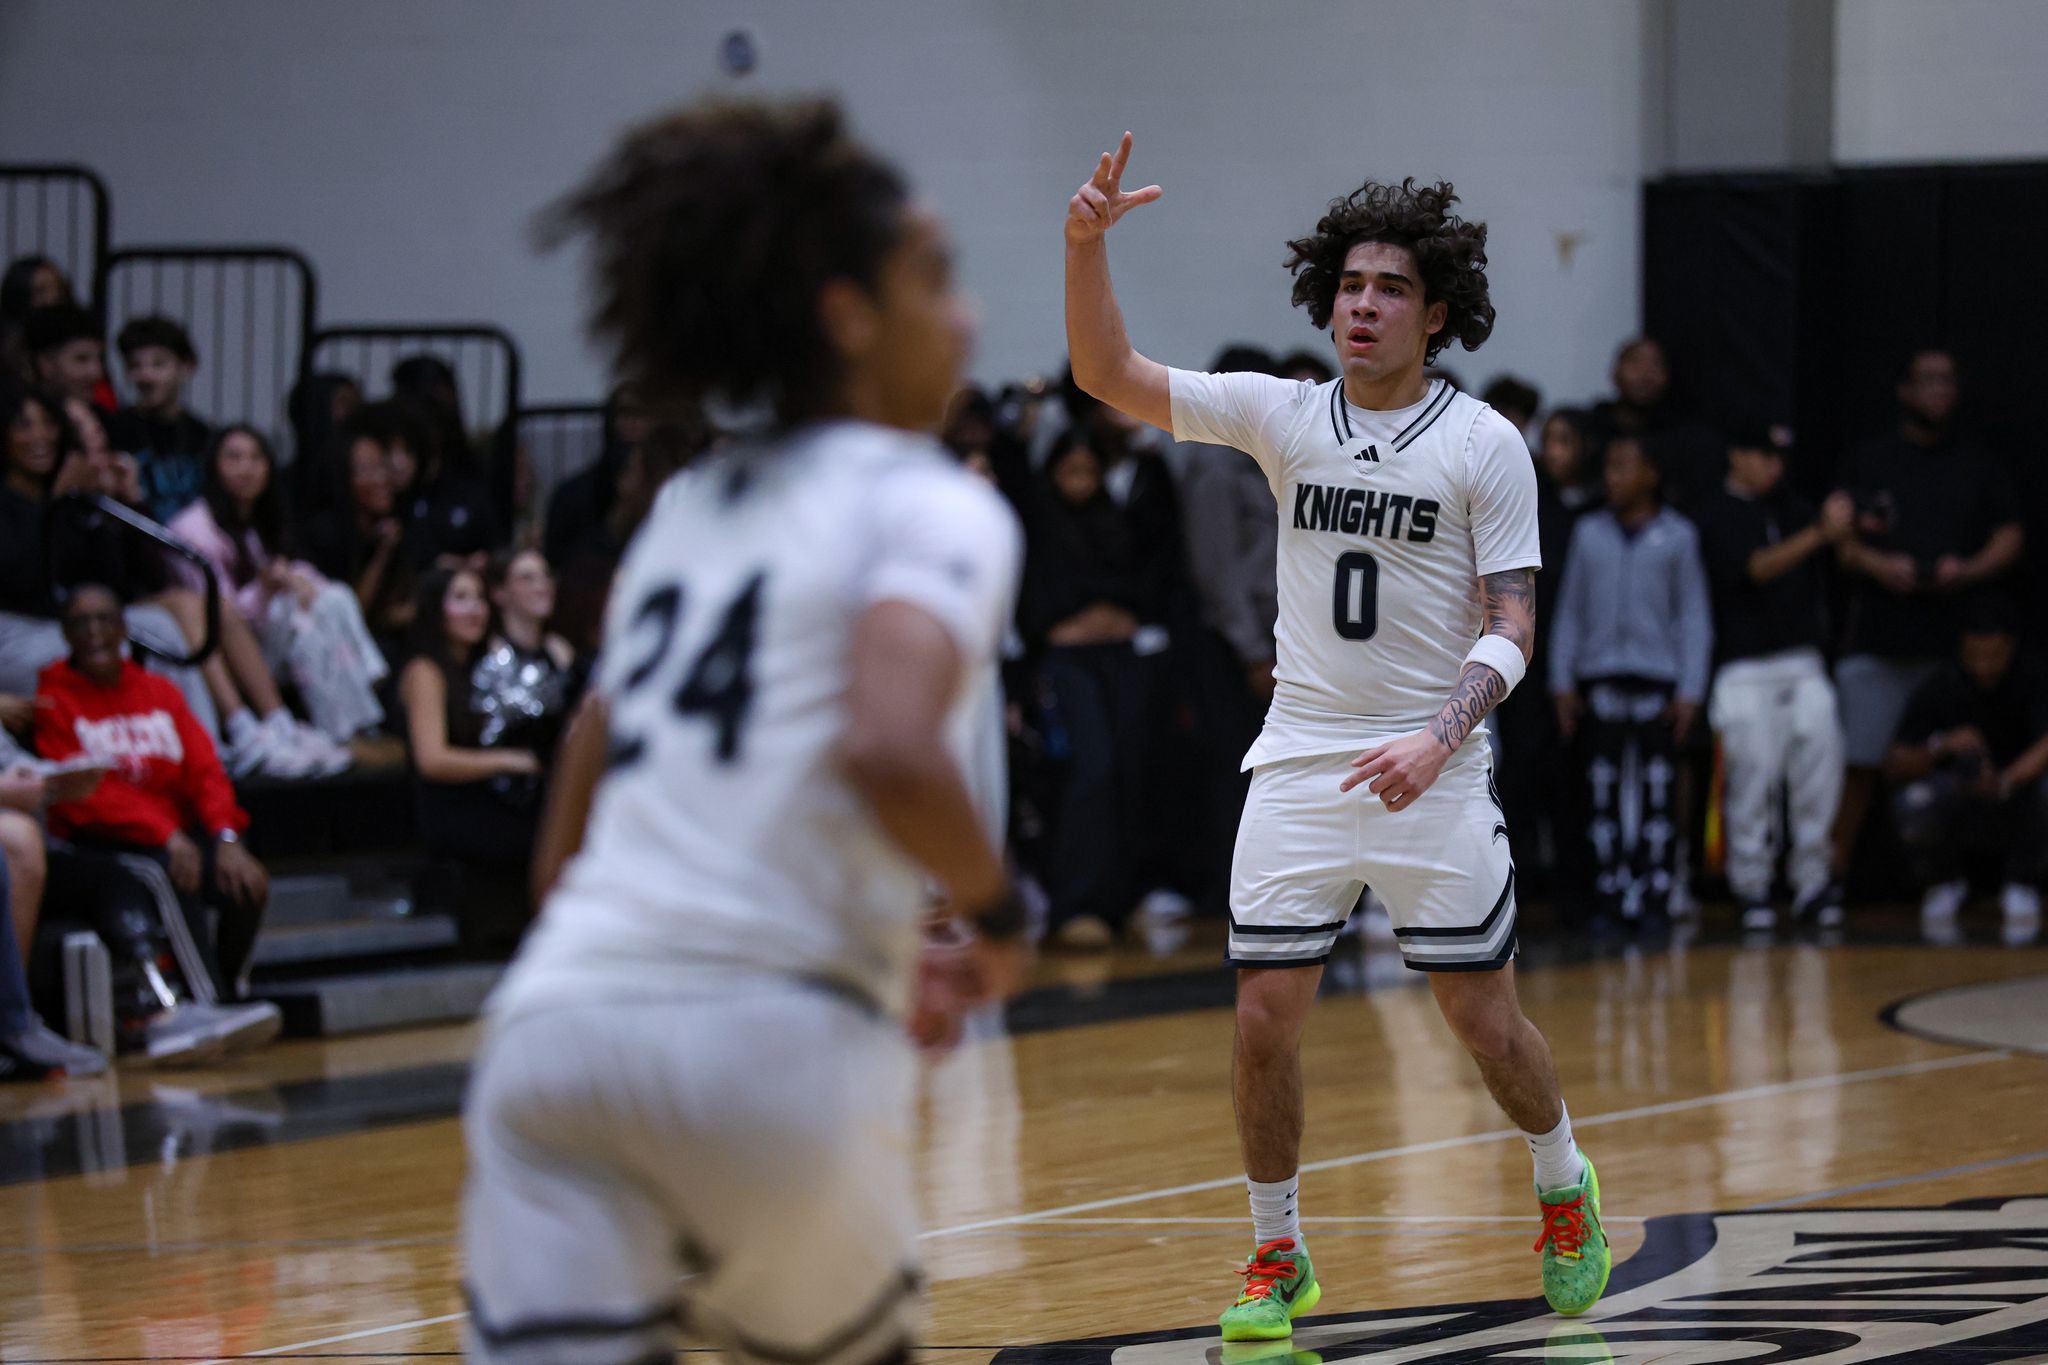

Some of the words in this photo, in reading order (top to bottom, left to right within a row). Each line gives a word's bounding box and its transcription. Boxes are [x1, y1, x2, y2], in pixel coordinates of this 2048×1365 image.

[1293, 483, 1440, 543] KNIGHTS
[1332, 550, 1380, 642] 0
[607, 570, 766, 770] 24
